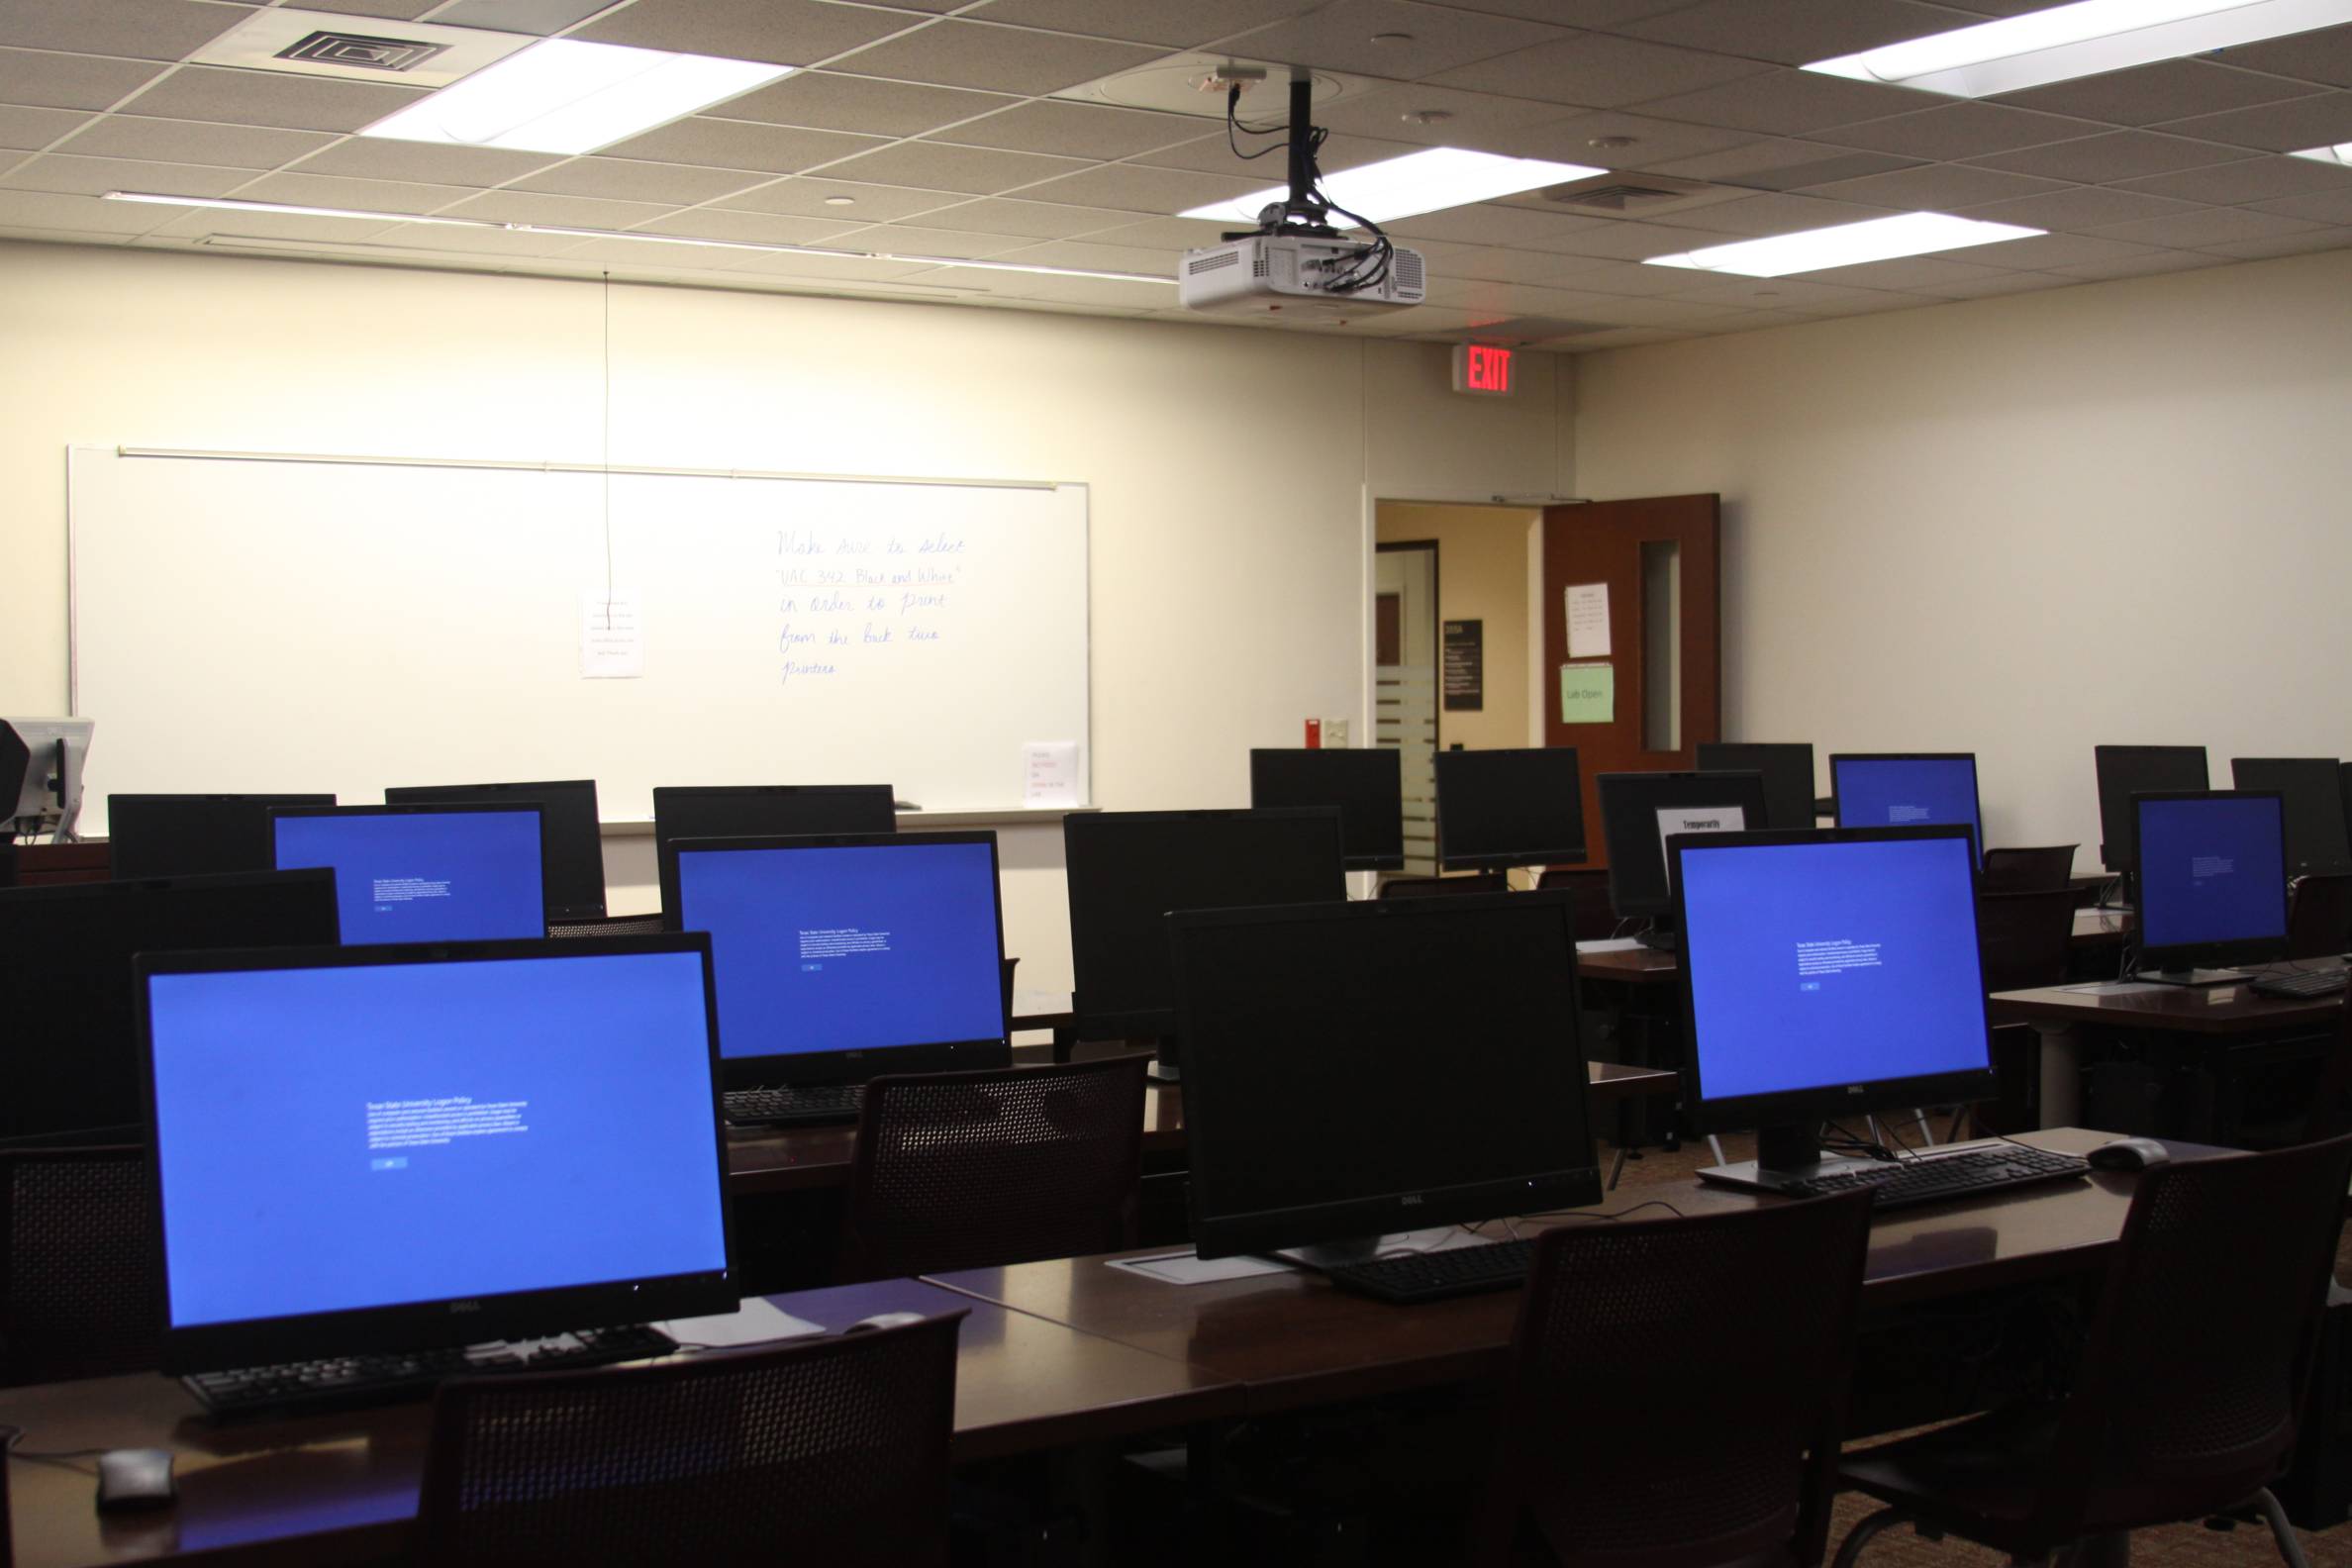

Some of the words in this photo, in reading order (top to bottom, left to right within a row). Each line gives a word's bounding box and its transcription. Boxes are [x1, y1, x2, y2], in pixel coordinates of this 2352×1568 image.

[1468, 344, 1512, 392] EXIT
[778, 531, 824, 554] Make
[887, 536, 906, 554] to
[919, 532, 966, 554] select
[891, 569, 912, 584] and
[780, 597, 798, 613] in
[810, 591, 854, 612] order
[867, 595, 885, 611] to
[901, 592, 950, 616] print
[779, 623, 816, 654] from
[829, 629, 848, 644] the
